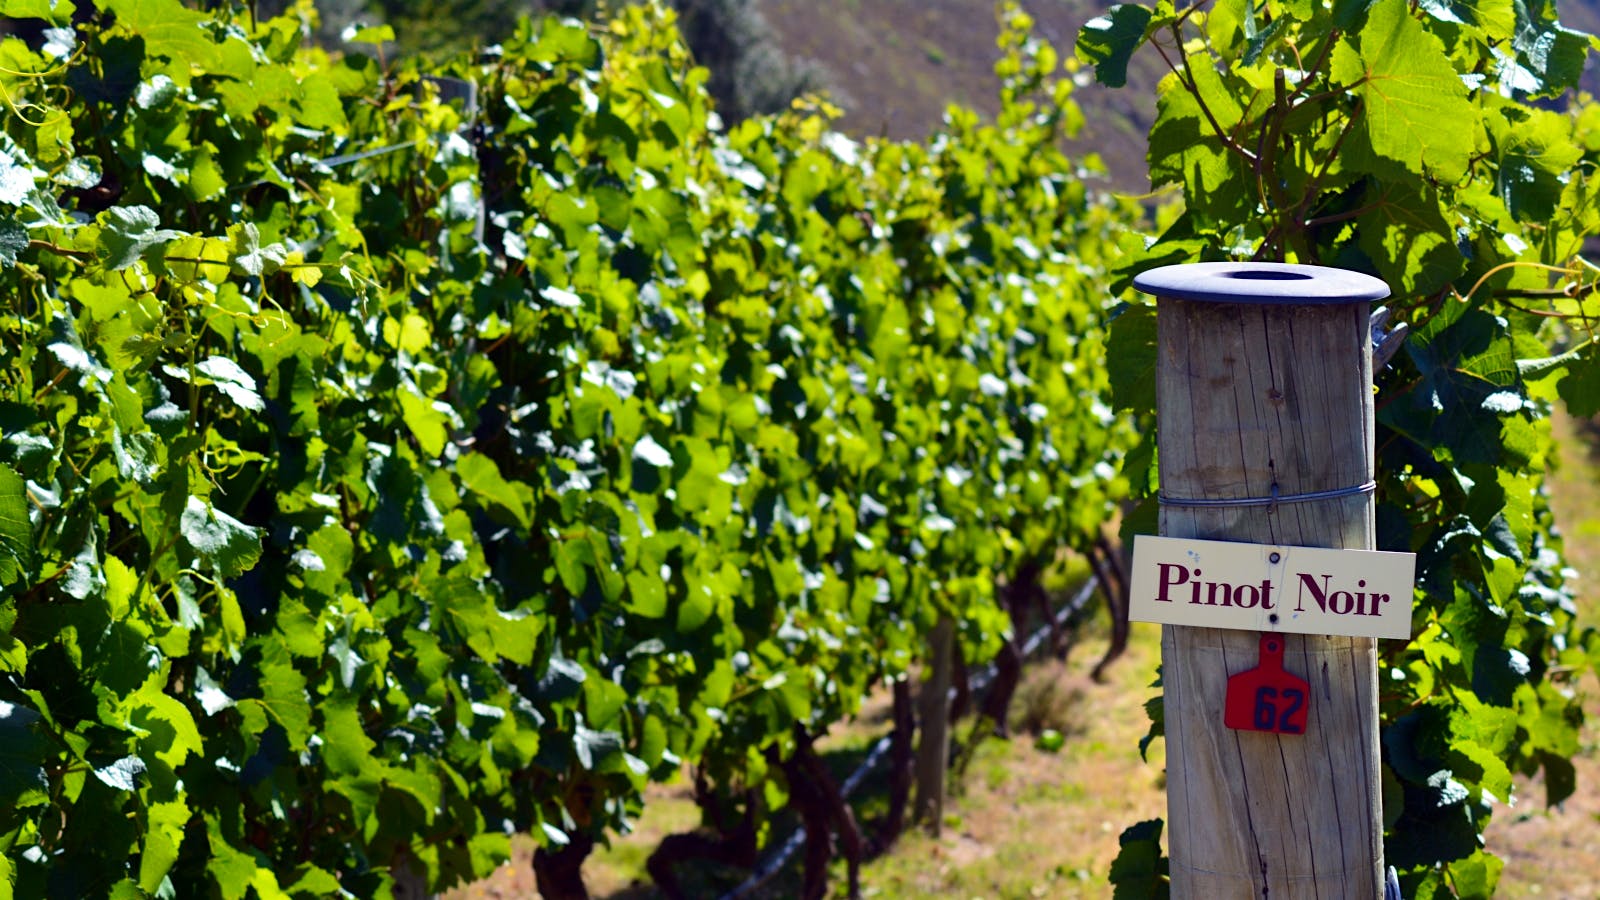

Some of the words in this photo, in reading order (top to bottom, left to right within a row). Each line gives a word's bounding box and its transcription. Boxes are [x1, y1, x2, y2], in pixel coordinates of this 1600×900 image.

[1155, 562, 1275, 610] Pinot
[1293, 573, 1390, 617] Noir
[1253, 686, 1304, 733] 62
